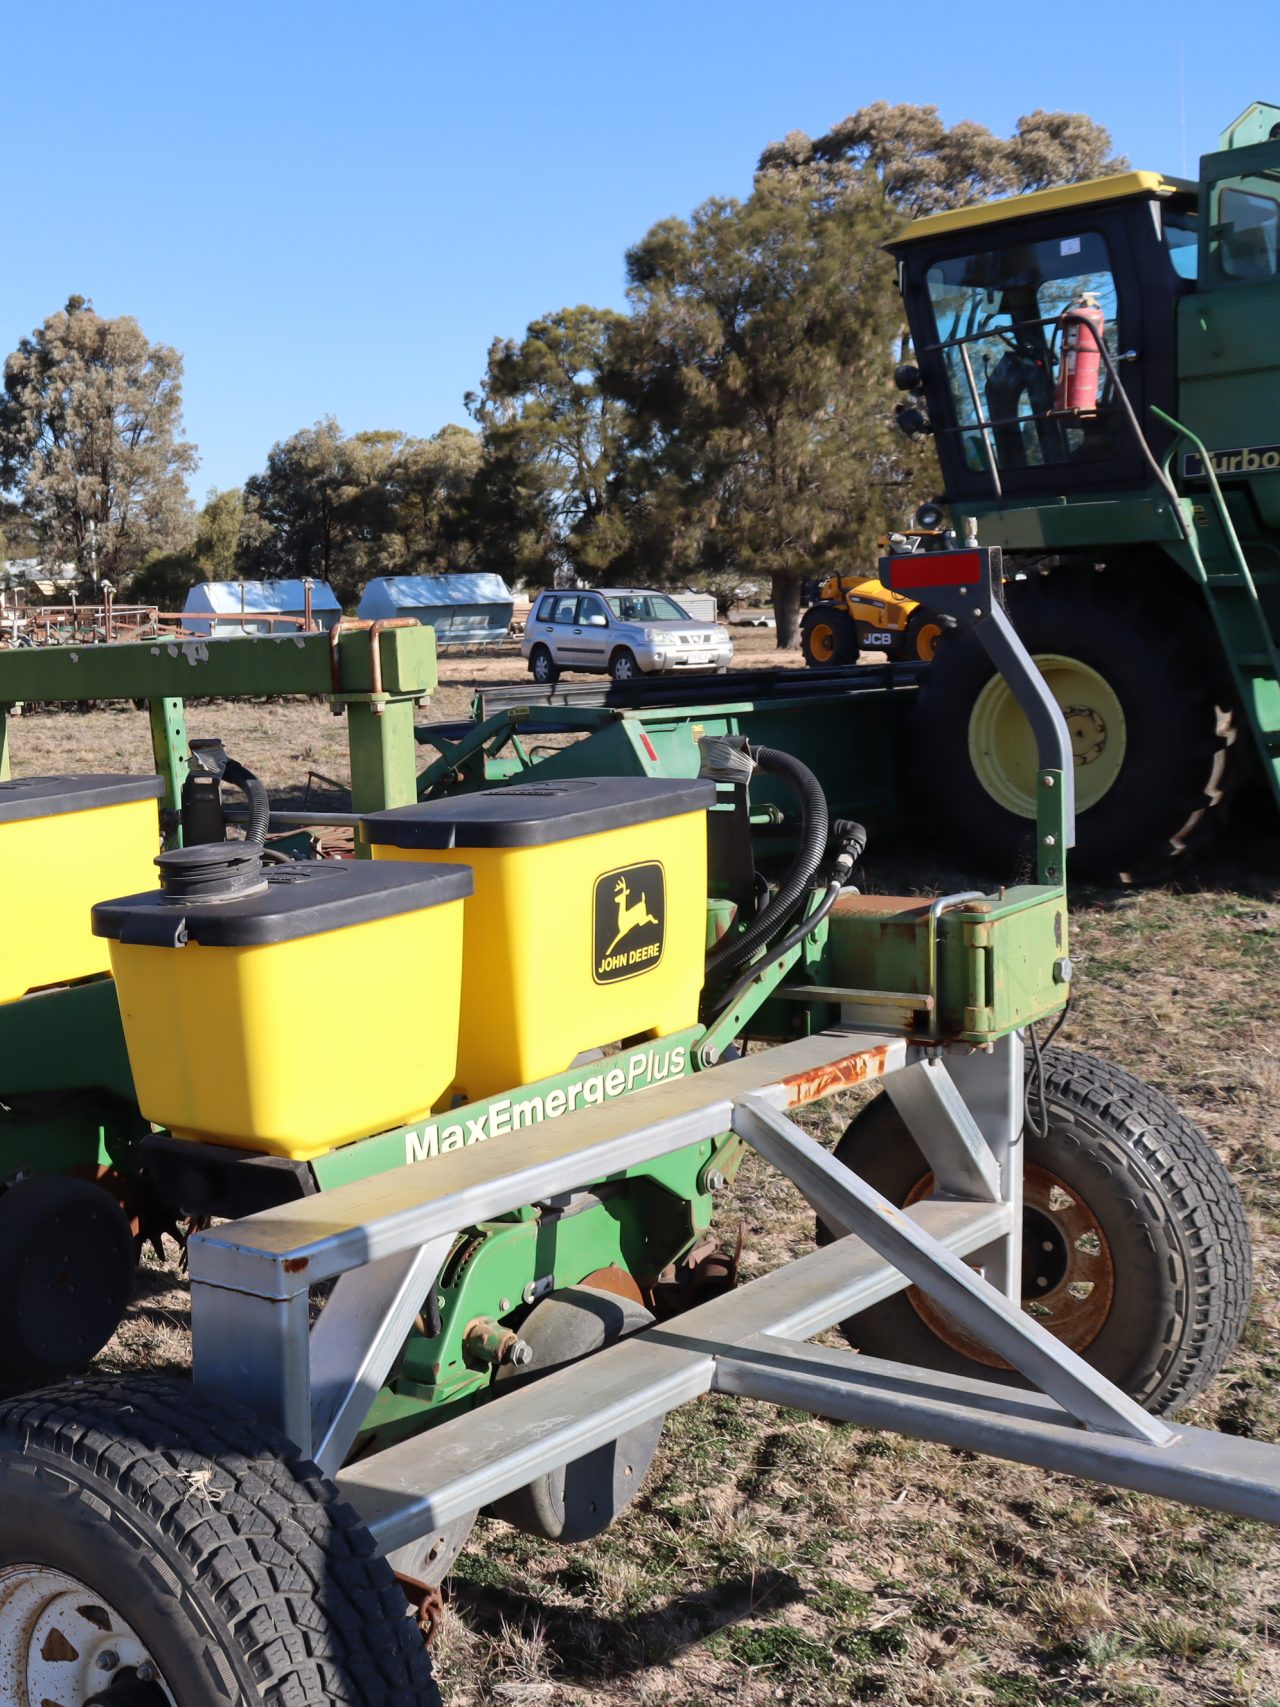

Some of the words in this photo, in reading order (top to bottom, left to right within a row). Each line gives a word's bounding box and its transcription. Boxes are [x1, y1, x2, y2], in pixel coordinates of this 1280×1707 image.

[863, 632, 892, 645] JCB
[598, 952, 628, 974] JOHN
[628, 942, 661, 965] DEERE
